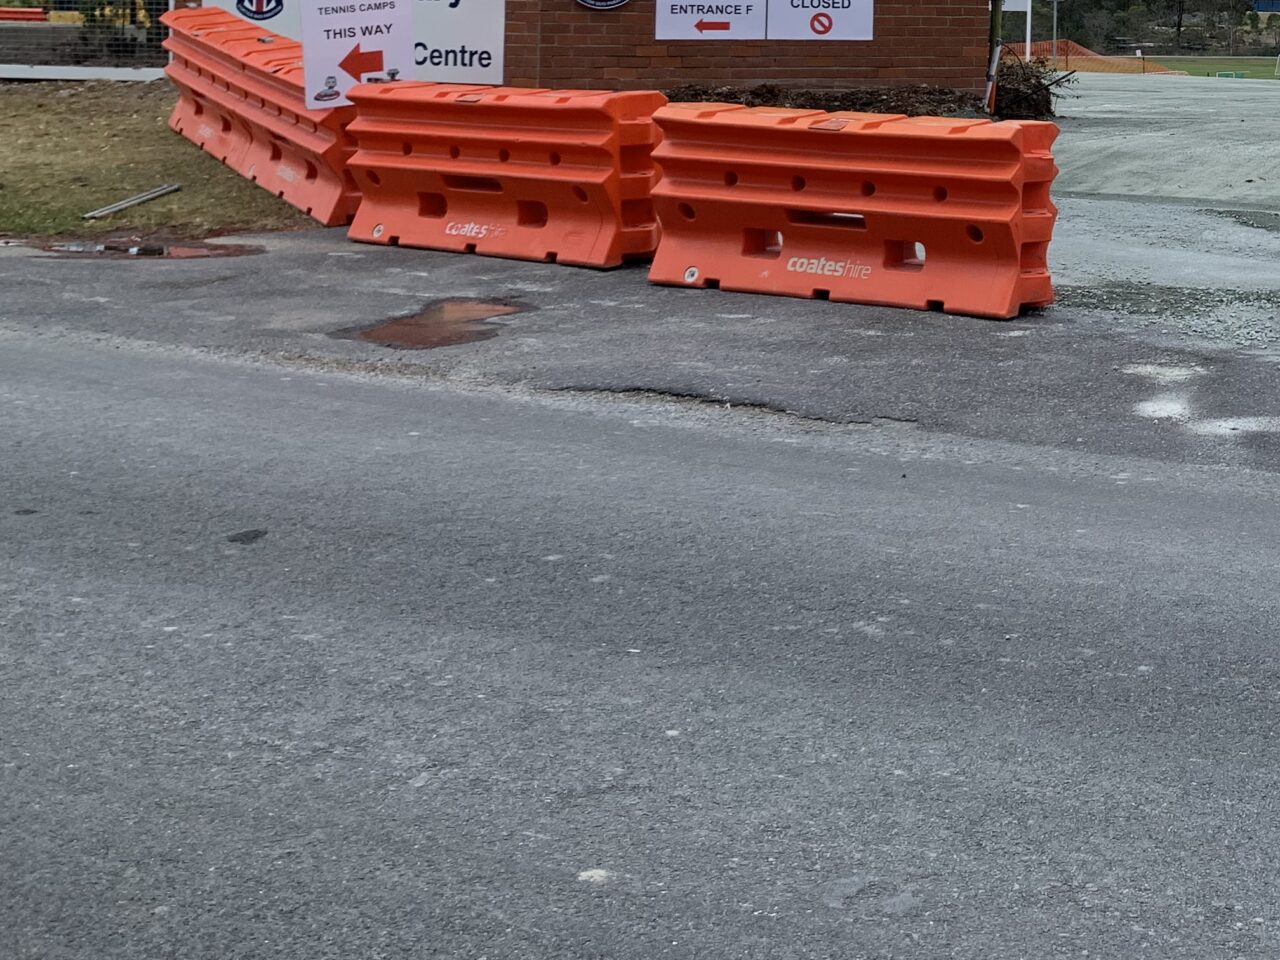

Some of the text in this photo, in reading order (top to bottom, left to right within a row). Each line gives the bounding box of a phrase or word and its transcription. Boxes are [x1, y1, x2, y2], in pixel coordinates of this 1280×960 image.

[317, 0, 396, 16] TENNIS CAMPS
[670, 4, 753, 15] ENTRANCE F
[323, 23, 393, 40] THIS WAY
[414, 42, 492, 68] Centre
